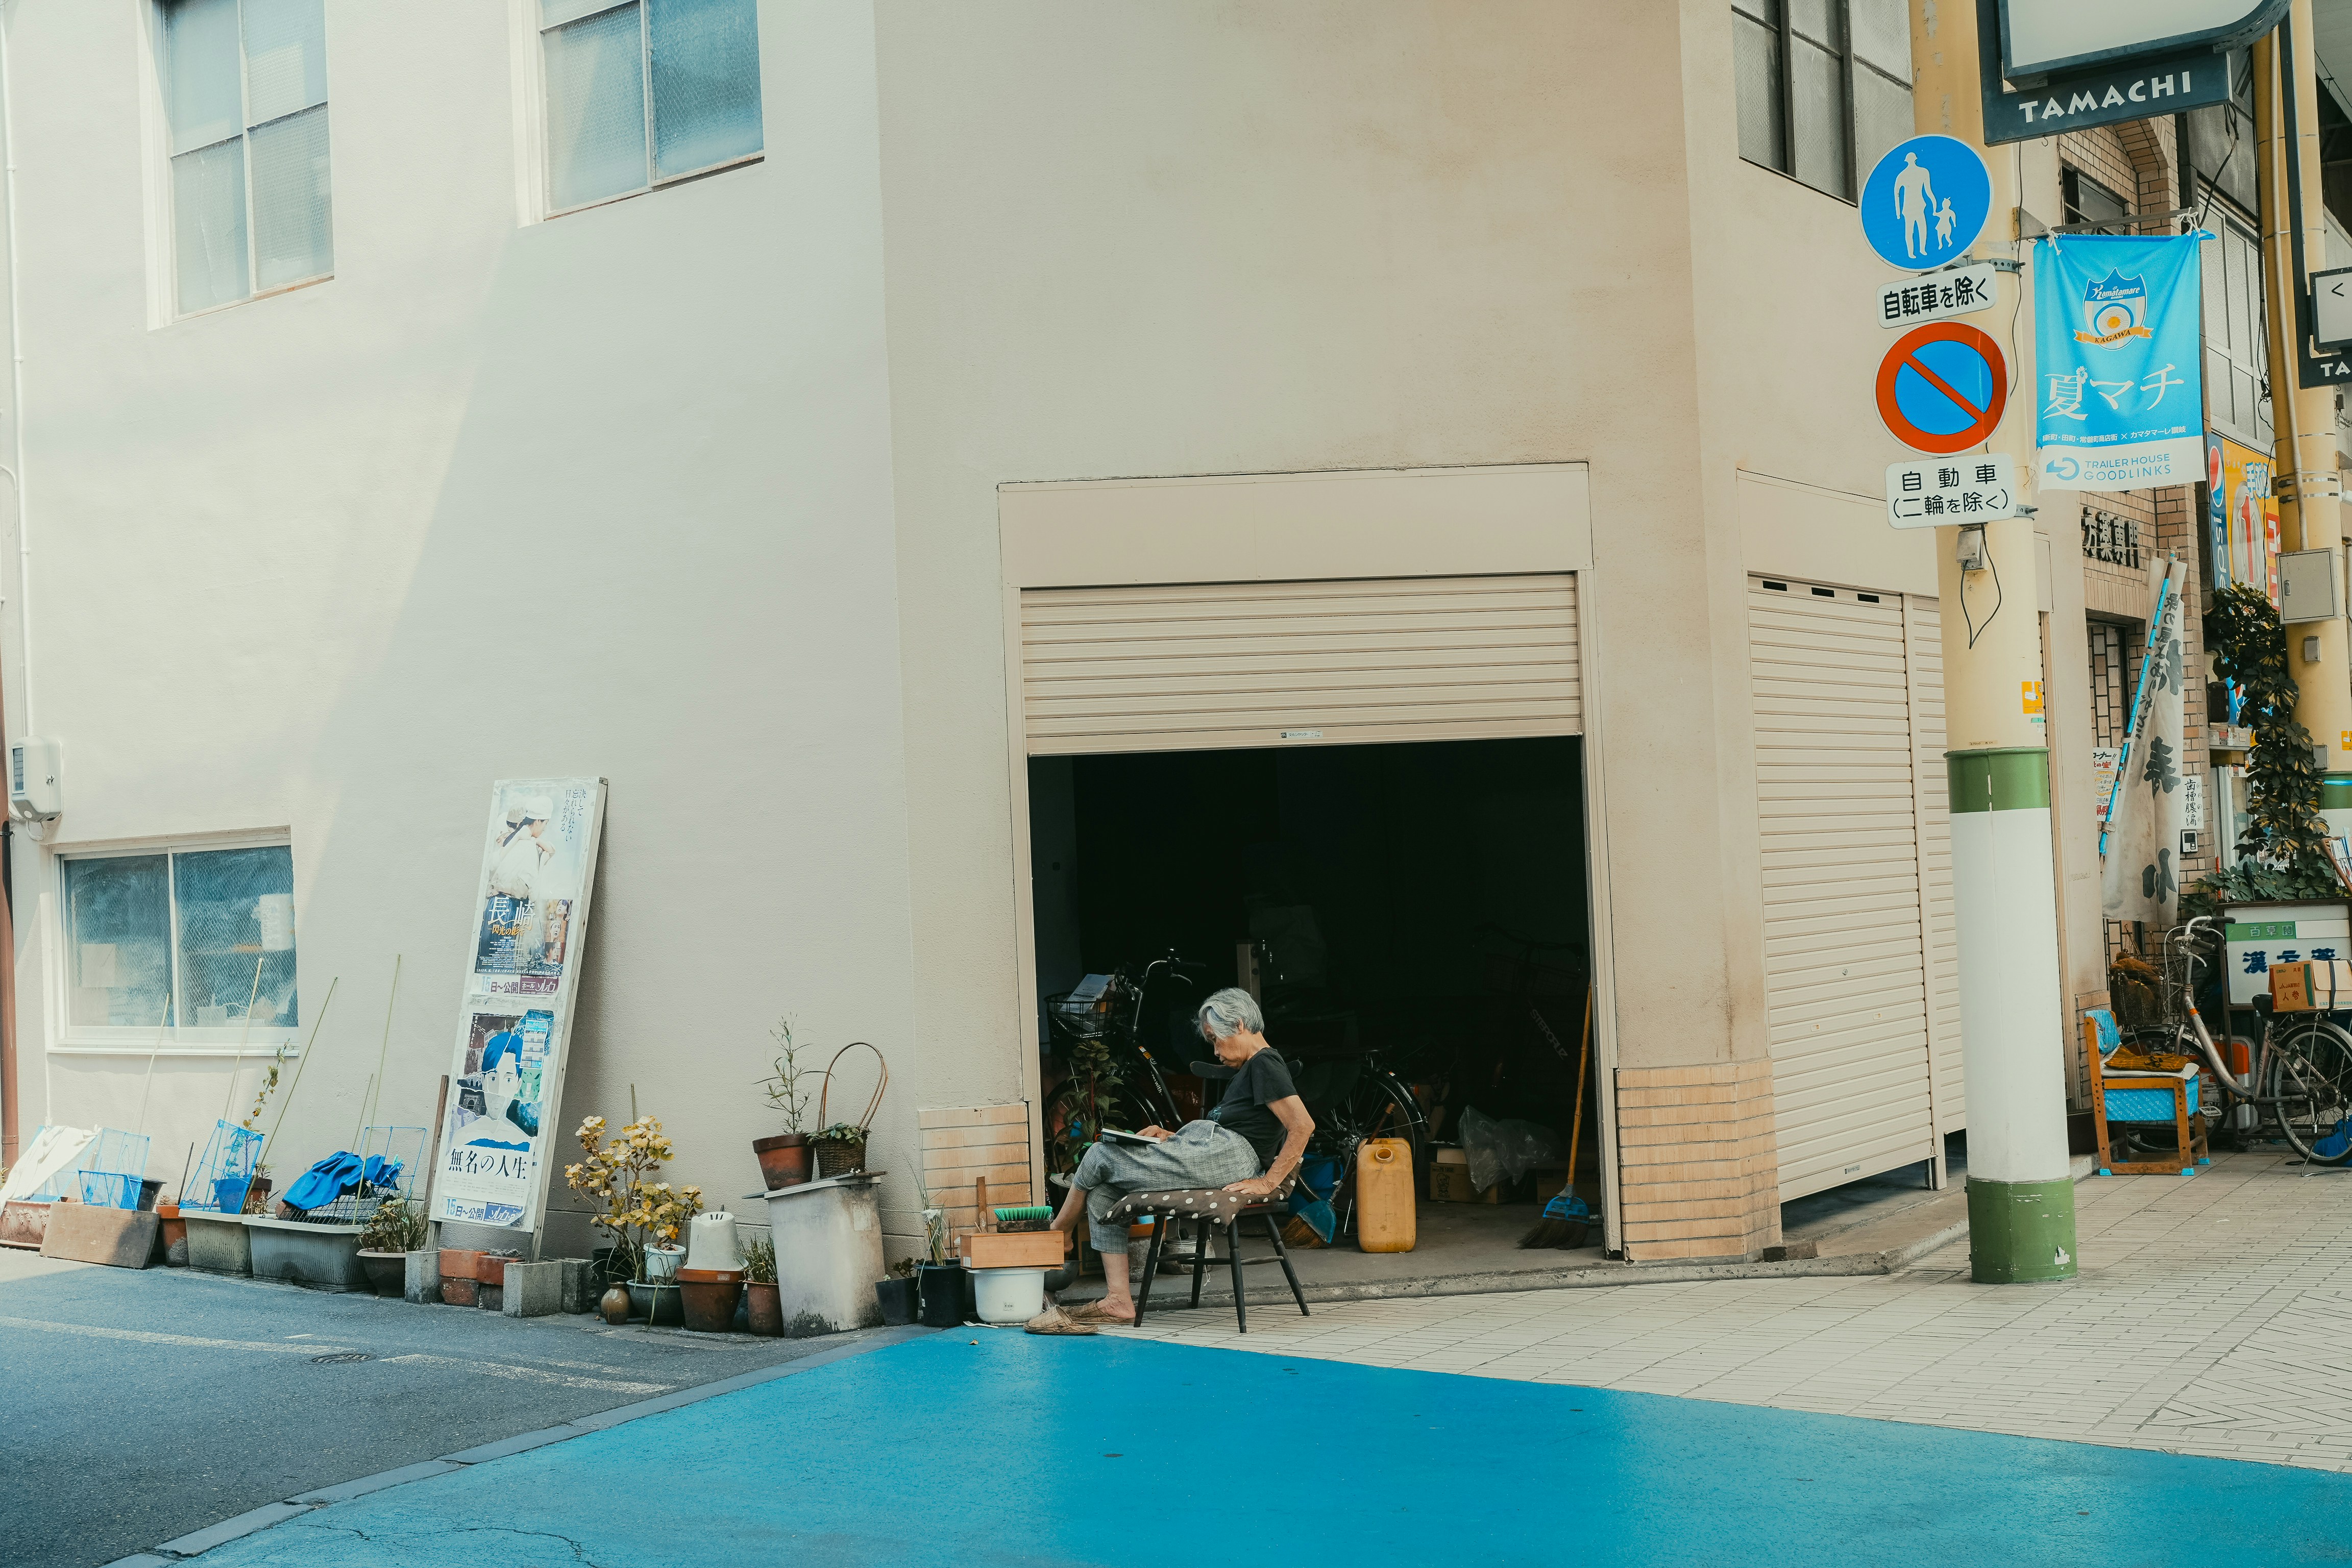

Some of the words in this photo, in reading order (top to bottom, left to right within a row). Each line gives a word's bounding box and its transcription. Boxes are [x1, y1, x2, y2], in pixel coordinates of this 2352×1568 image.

[2019, 71, 2191, 123] TAMACHI
[1883, 276, 1988, 320] 自転車を除く
[2091, 284, 2140, 300] Kamatamare
[2095, 329, 2132, 343] KAGAWA
[2042, 363, 2185, 421] 夏マチ
[2130, 426, 2187, 439] カマタマーレ讃岐
[2084, 464, 2171, 481] GOODLINKS
[2085, 458, 2129, 469] TRAILER
[2132, 453, 2170, 465] HOUSE
[1902, 463, 1997, 492] 自動車
[1893, 488, 2008, 519] (二輪を除く)
[560, 790, 571, 831] 日々がある
[566, 789, 579, 842] 忘れられない
[2185, 778, 2197, 826] 歯槽膿漏
[487, 896, 536, 931] 長崎
[2249, 925, 2293, 937] 百草園
[2282, 990, 2299, 1001] 人参
[1155, 1081, 1163, 1094] with
[449, 1148, 527, 1180] 無名の人生
